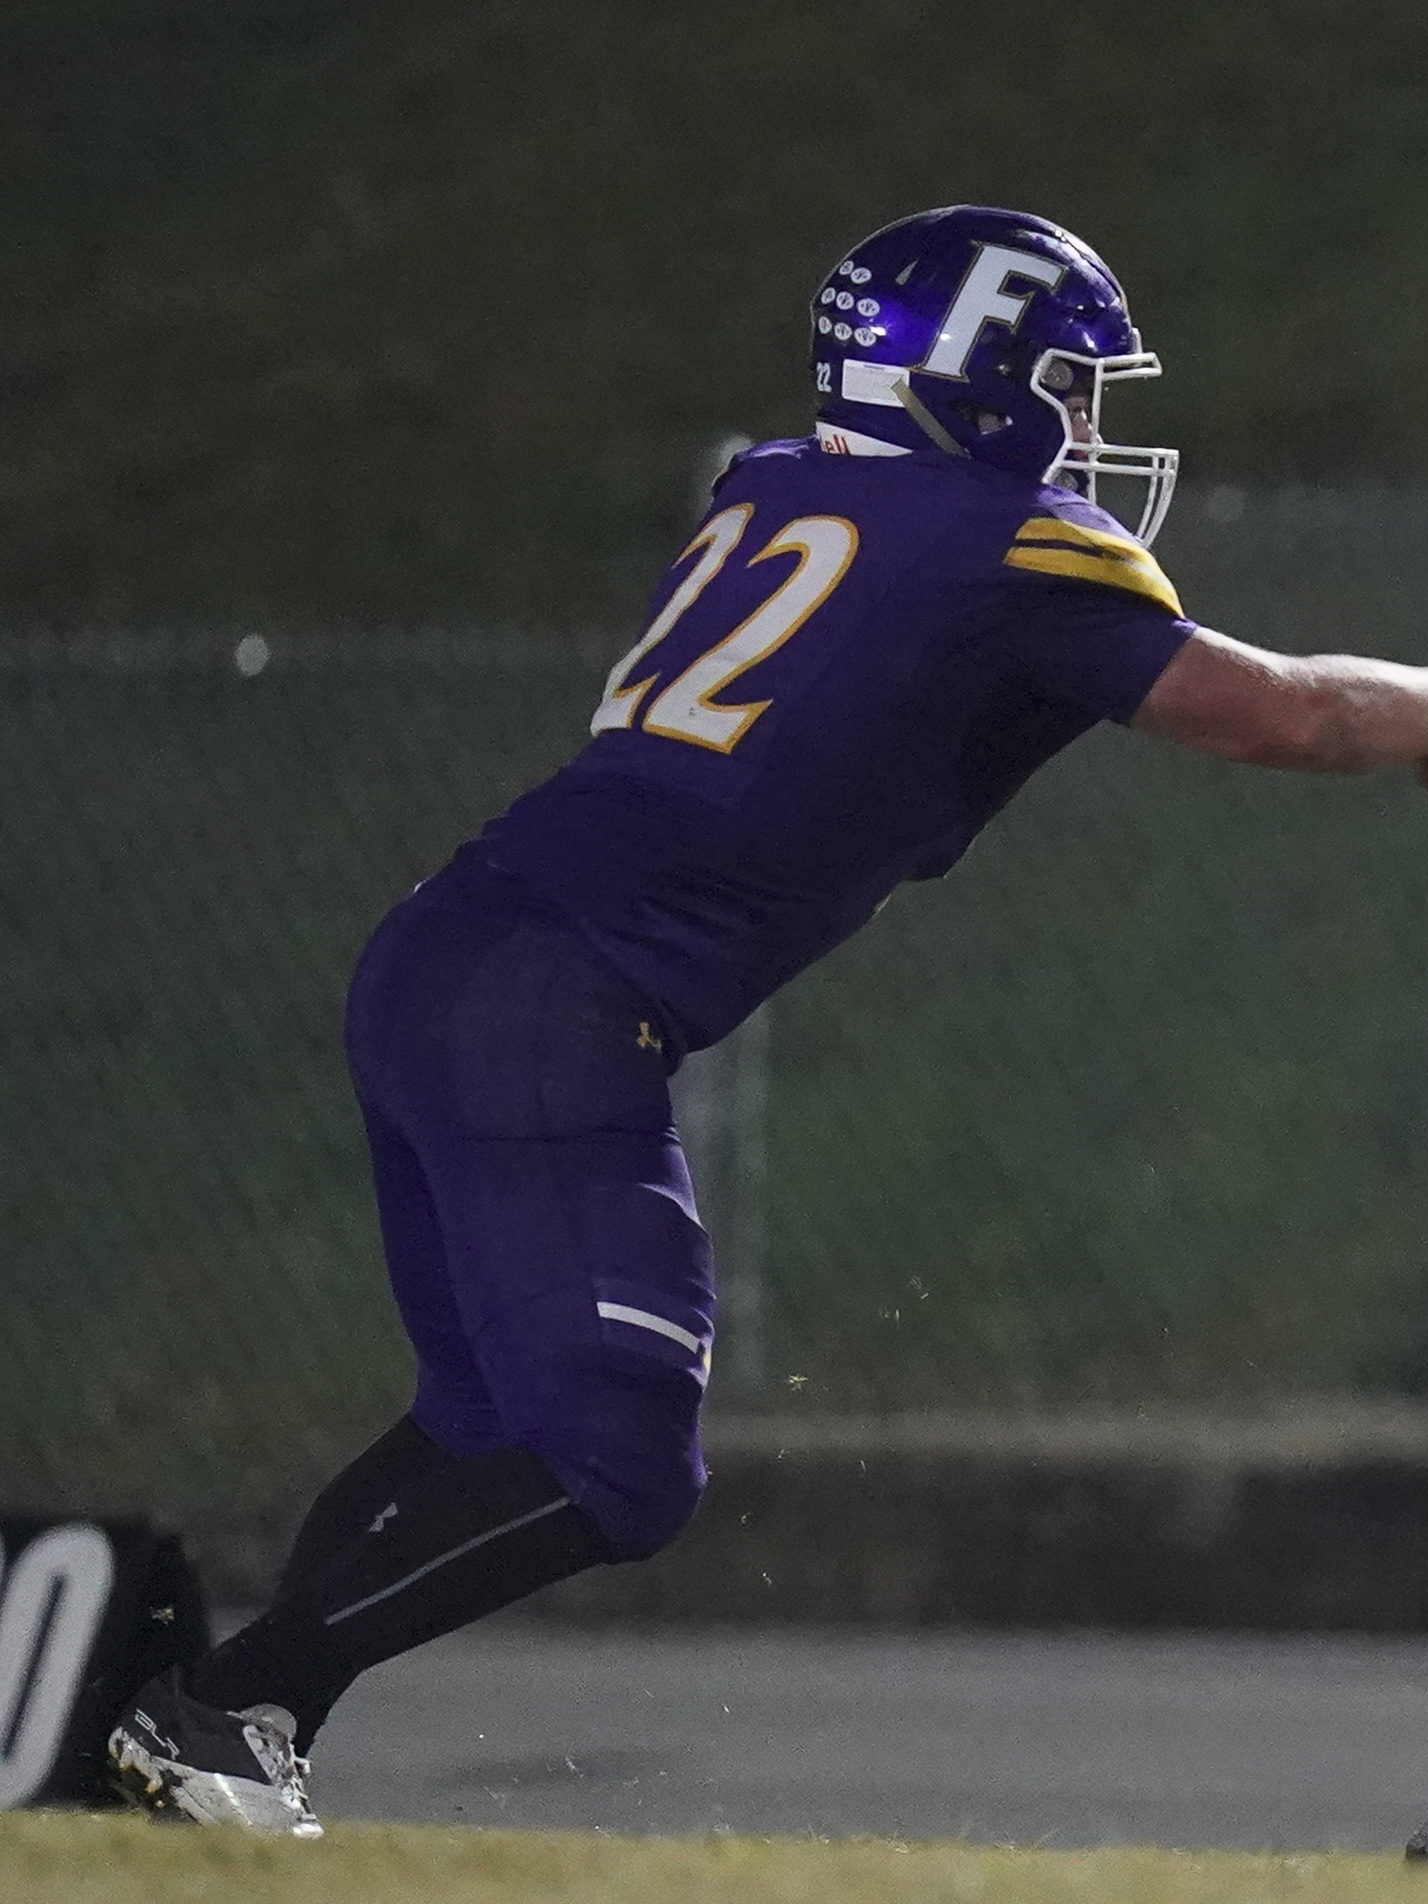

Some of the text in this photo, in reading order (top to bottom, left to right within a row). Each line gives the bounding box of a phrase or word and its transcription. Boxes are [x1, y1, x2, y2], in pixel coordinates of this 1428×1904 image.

[816, 362, 832, 393] 22
[908, 240, 1069, 383] F
[590, 502, 860, 755] 22
[0, 1521, 116, 1810] 0
